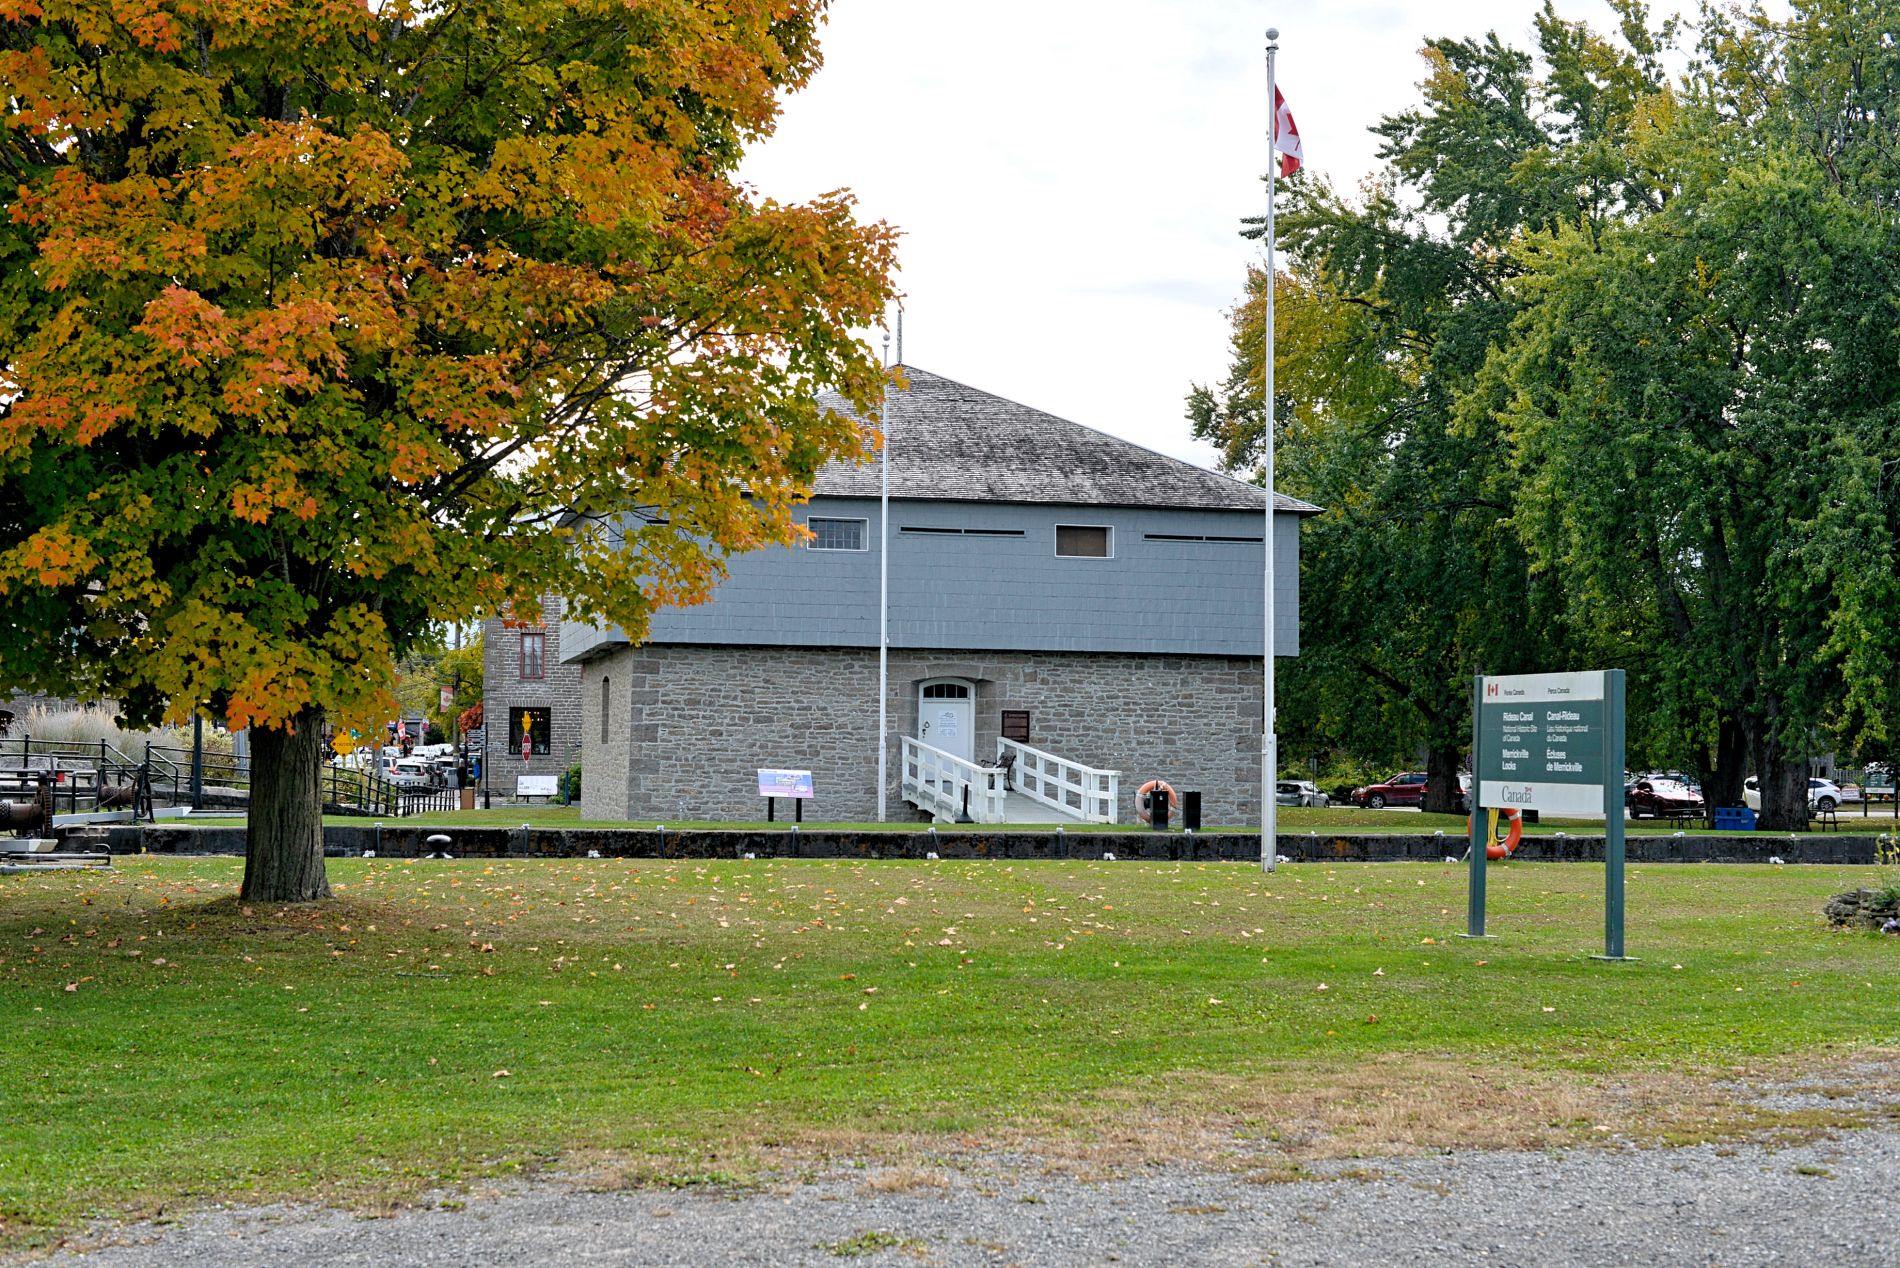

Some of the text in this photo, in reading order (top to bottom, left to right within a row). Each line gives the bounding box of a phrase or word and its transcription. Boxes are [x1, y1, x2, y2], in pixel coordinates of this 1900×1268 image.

[1503, 711, 1533, 721] Rideau Canal
[1546, 711, 1580, 721] Canal-Rideau
[1546, 724, 1588, 734] Lieu historique national
[1507, 734, 1520, 742] Canada
[1552, 733, 1567, 742] Canada
[522, 743, 531, 753] STOP
[1546, 747, 1566, 759] Écluses
[1502, 749, 1529, 759] Merrickville
[1502, 761, 1516, 770] Locks
[1546, 762, 1583, 772] de Merrickville
[1502, 786, 1532, 804] Canada
